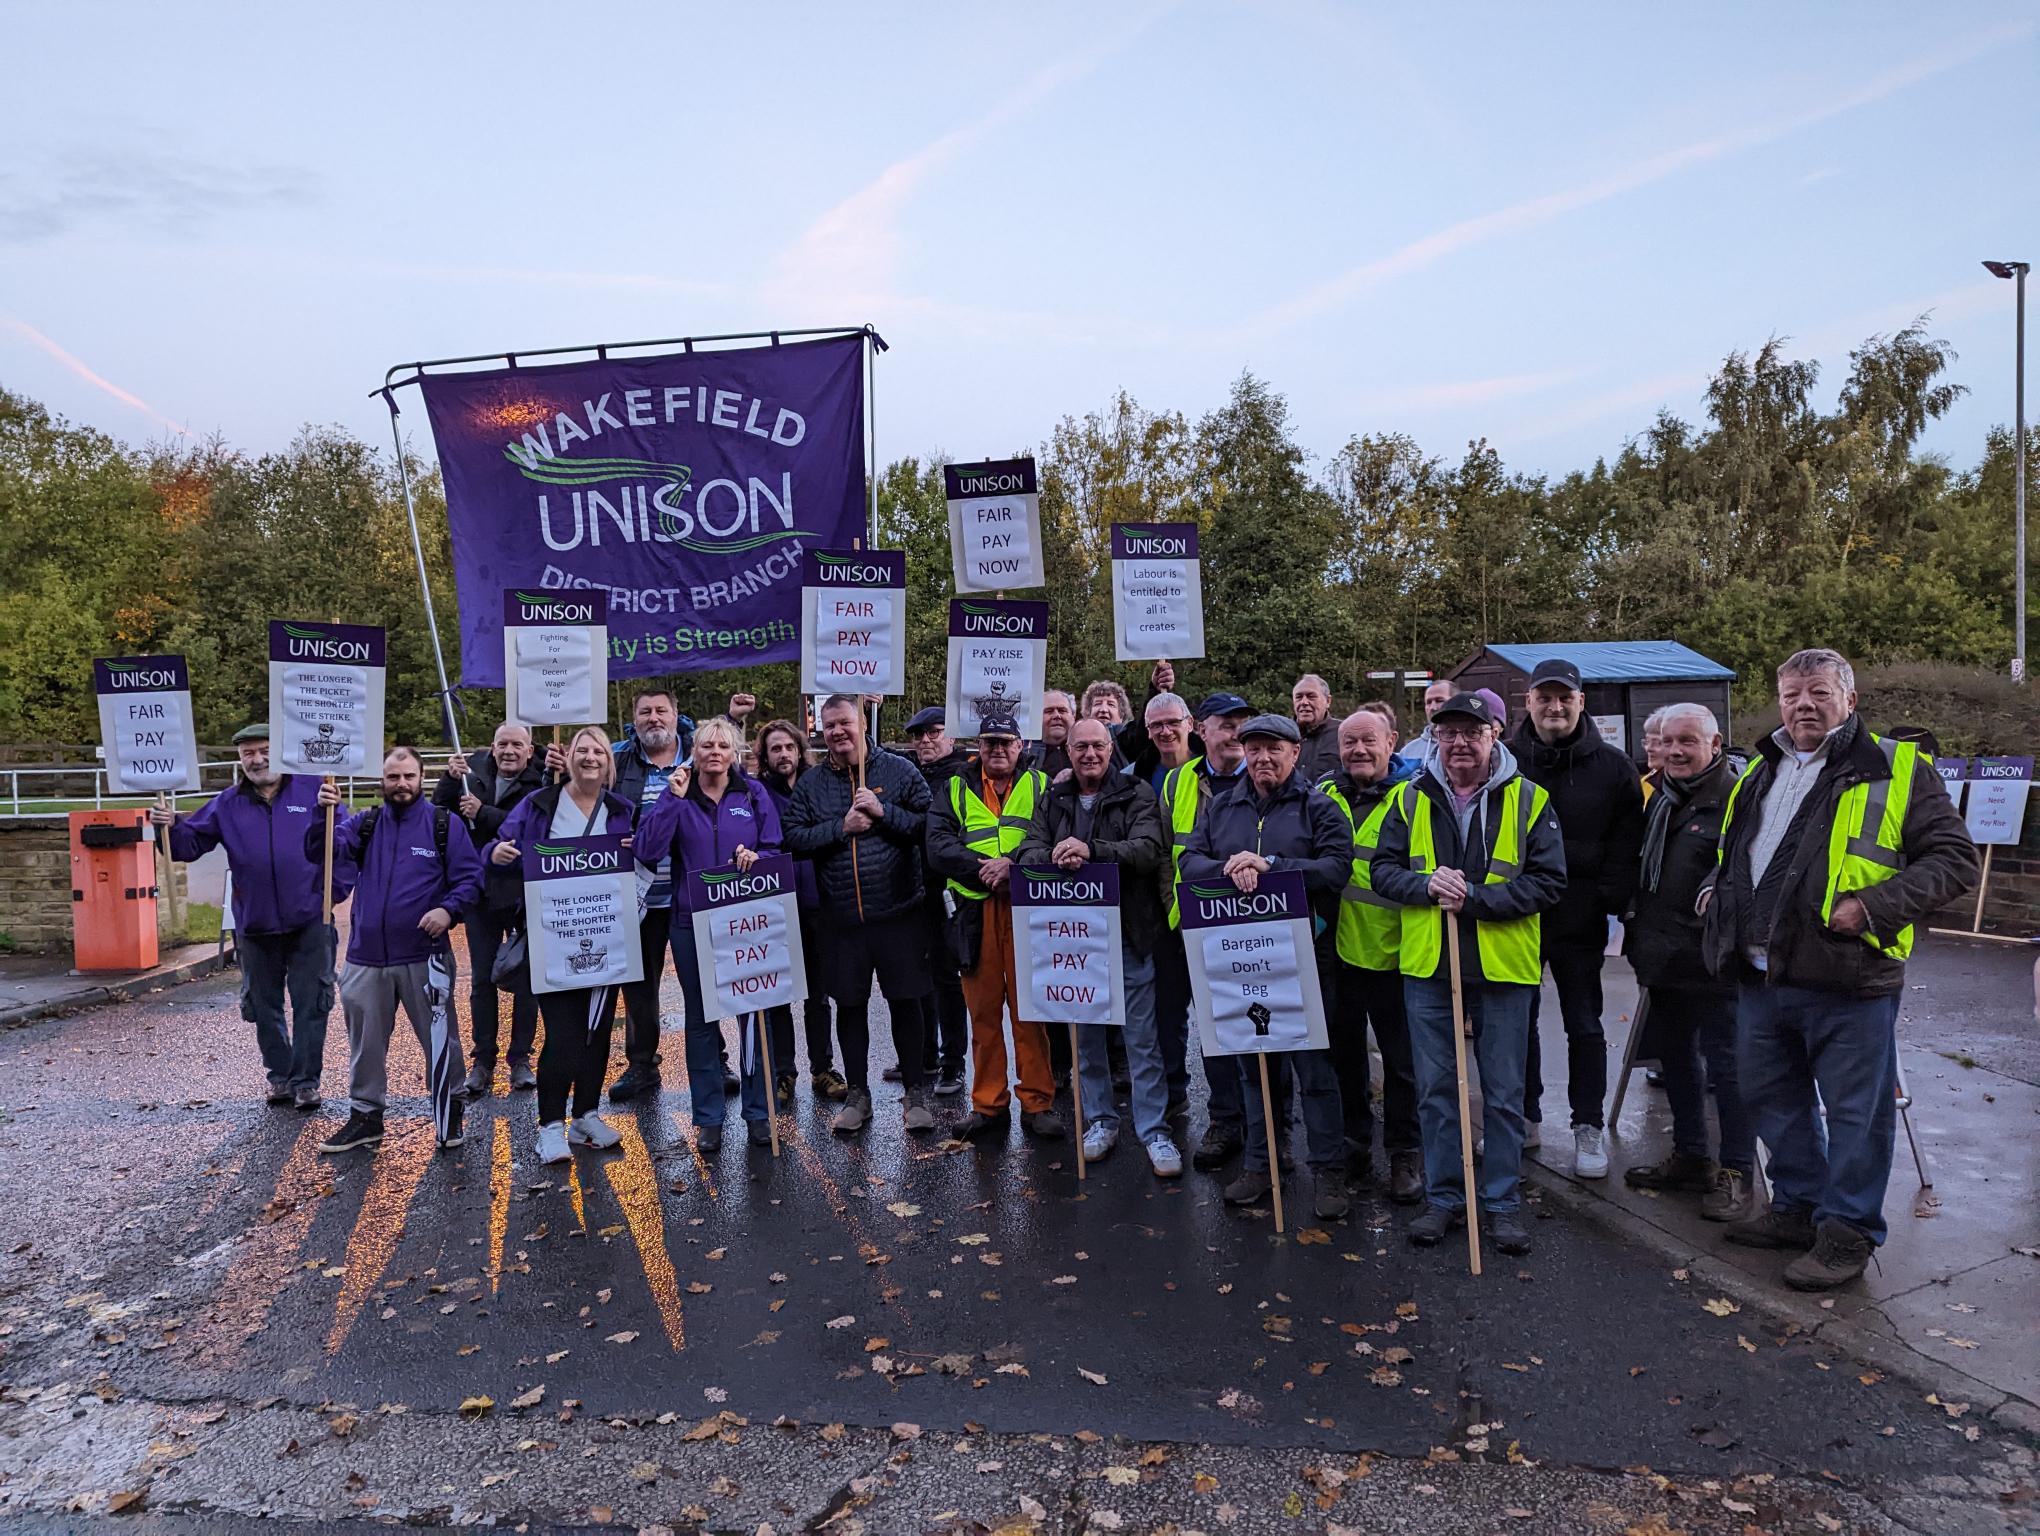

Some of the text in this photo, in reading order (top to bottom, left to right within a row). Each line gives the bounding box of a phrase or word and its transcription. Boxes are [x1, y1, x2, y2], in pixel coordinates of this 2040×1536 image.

[507, 386, 807, 471] WAKEFIELD
[960, 474, 1023, 493] UNISON
[538, 471, 794, 552] UNISON
[977, 507, 1012, 523] FAIR
[982, 534, 1012, 549] PAY
[1125, 538, 1186, 555] UNISON
[690, 539, 803, 610] BRANCH
[820, 565, 891, 582] UNISON
[978, 559, 1019, 575] NOW
[1133, 568, 1177, 579] Labour is
[1130, 586, 1181, 597] entitled to
[521, 604, 592, 621] UNISON
[835, 602, 874, 617] FAIR
[1146, 605, 1167, 615] all it
[964, 615, 1034, 633] UNISON
[1139, 623, 1176, 632] creates
[540, 634, 568, 642] Fighting
[607, 619, 795, 662] ity is Strength
[838, 631, 871, 646] PAY
[289, 638, 369, 660] UNISON
[972, 648, 1023, 660] PAY RISE
[542, 668, 568, 676] Decent
[831, 660, 877, 675] NOW
[111, 670, 176, 689] UNISON
[297, 674, 353, 684] THE LONGER
[545, 680, 566, 688] Wage
[299, 686, 351, 696] THE PICKET
[549, 691, 561, 699] For
[295, 698, 354, 709] THE SHORTER
[129, 704, 164, 720] FAIR
[299, 711, 351, 721] THE STRIKE
[134, 732, 165, 747] PAY
[132, 759, 175, 774] NOW
[1981, 766, 2023, 777] UNISON
[541, 851, 618, 874] UNISON
[707, 872, 780, 903] UNISON
[1029, 881, 1104, 900] UNISON
[552, 894, 611, 907] THE LONGER
[1200, 892, 1287, 920] UNISON
[556, 904, 610, 917] THE PICKET
[551, 914, 616, 929] THE SHORTER
[729, 914, 769, 936] FAIR
[557, 926, 611, 939] THE STRIKE
[1048, 921, 1090, 939] FAIR
[1221, 935, 1274, 953] Bargain
[735, 944, 769, 966] PAY
[1053, 953, 1088, 970] PAY
[732, 972, 778, 996] NOW
[1242, 982, 1268, 998] Beg
[1046, 986, 1097, 1004] NOW
